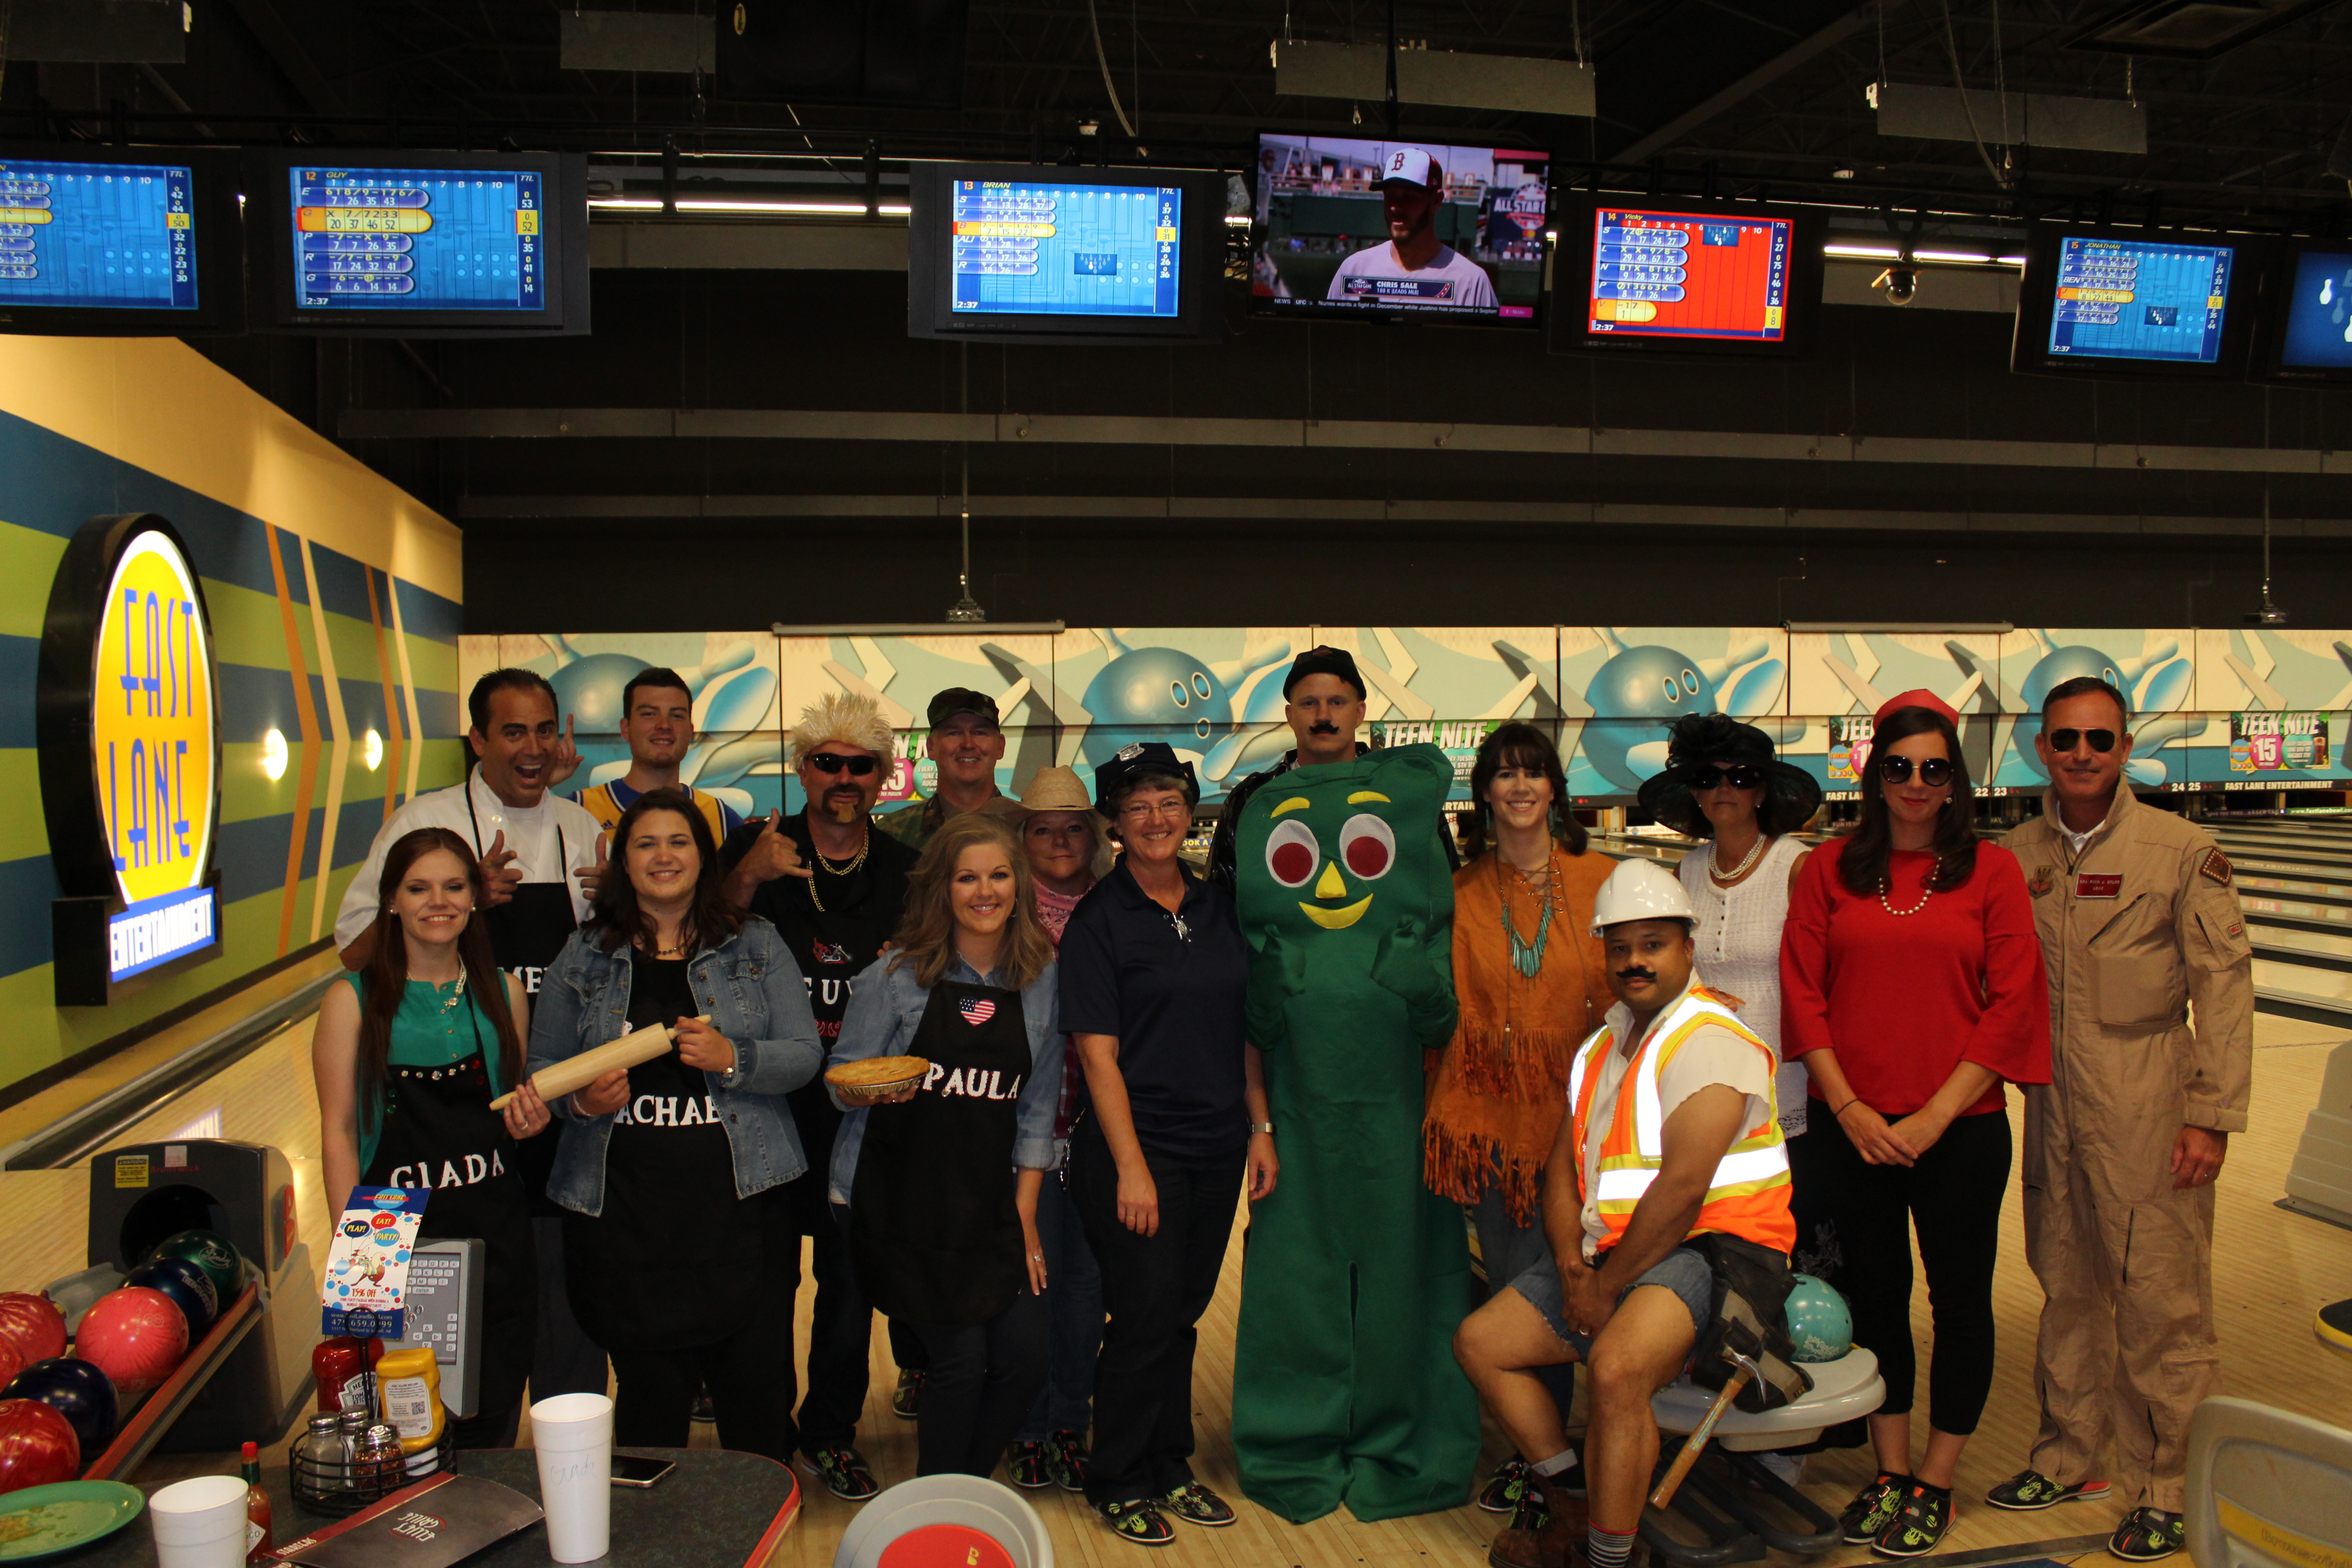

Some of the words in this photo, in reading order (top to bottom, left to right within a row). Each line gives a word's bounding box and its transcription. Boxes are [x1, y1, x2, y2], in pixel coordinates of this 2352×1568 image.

[305, 172, 316, 180] 12
[366, 197, 376, 205] 35
[384, 197, 395, 205] 43
[522, 199, 533, 208] 53
[1494, 199, 1512, 212] ALL
[1514, 200, 1536, 212] STAR
[330, 219, 341, 229] 20
[349, 219, 358, 229] 37
[367, 220, 377, 229] 46
[385, 220, 395, 229] 52
[522, 222, 533, 231] 52
[523, 244, 534, 252] 35
[524, 264, 533, 272] 41
[120, 588, 193, 717] FAST
[2241, 712, 2282, 736] TEEN
[2284, 712, 2321, 735] NITE
[1384, 722, 1436, 749] TEEN
[1439, 721, 1488, 749] NITE
[2171, 784, 2185, 792] 24
[2189, 783, 2201, 791] 25
[2245, 782, 2267, 790] LANE
[2269, 781, 2333, 789] ENTERTAINMENT
[1826, 792, 1847, 800] FAST
[1849, 792, 1863, 800] LA
[1975, 787, 1989, 797] 22
[1994, 787, 2007, 796] 23
[108, 736, 191, 872] LANE
[110, 894, 213, 972] ENTERTAINMENT
[921, 1062, 1021, 1100] PAULA
[390, 1149, 505, 1190] GIADA
[352, 1288, 365, 1297] 15%
[367, 1289, 377, 1297] OFF
[397, 1512, 439, 1528] GRILLE
[276, 1537, 317, 1555] STARTERS
